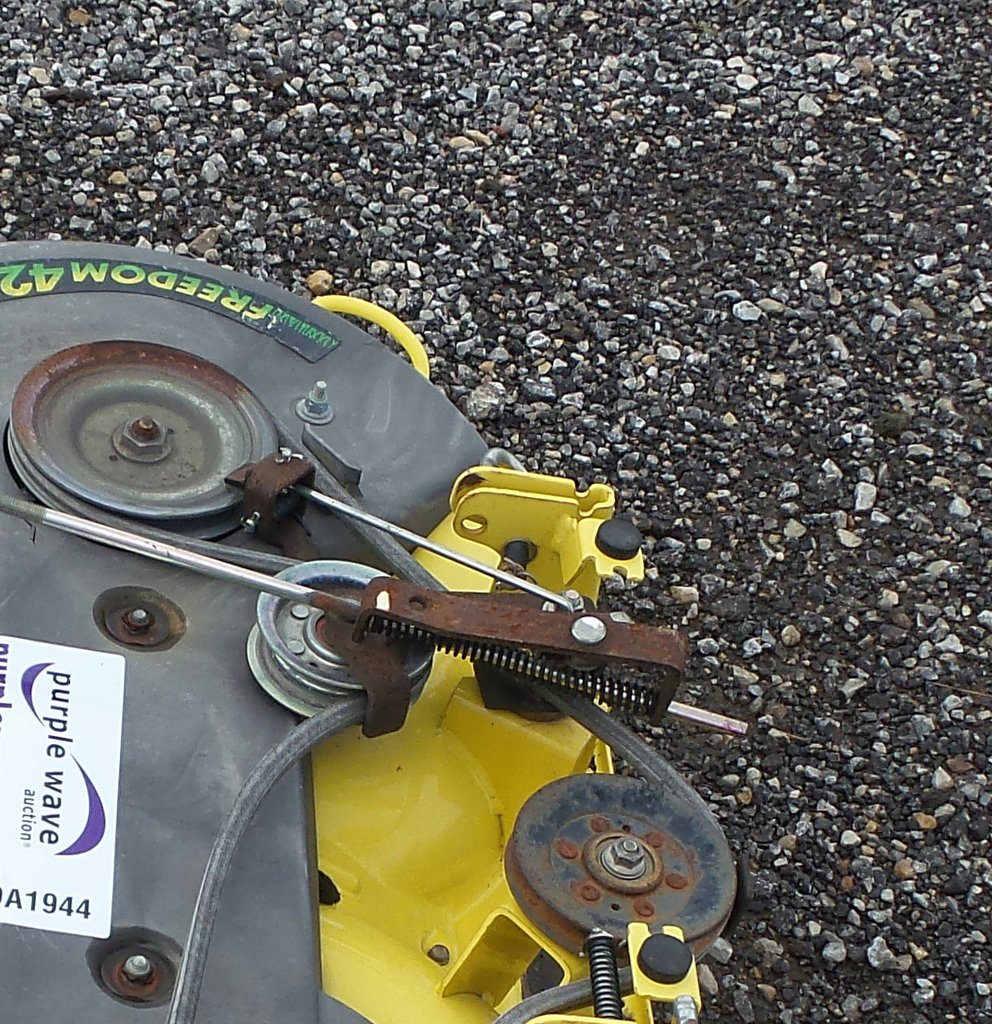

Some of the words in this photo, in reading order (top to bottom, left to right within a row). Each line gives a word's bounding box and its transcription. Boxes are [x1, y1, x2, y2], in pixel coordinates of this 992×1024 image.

[71, 261, 271, 320] FREEDOM
[42, 670, 73, 759] purple
[39, 771, 64, 845] wave
